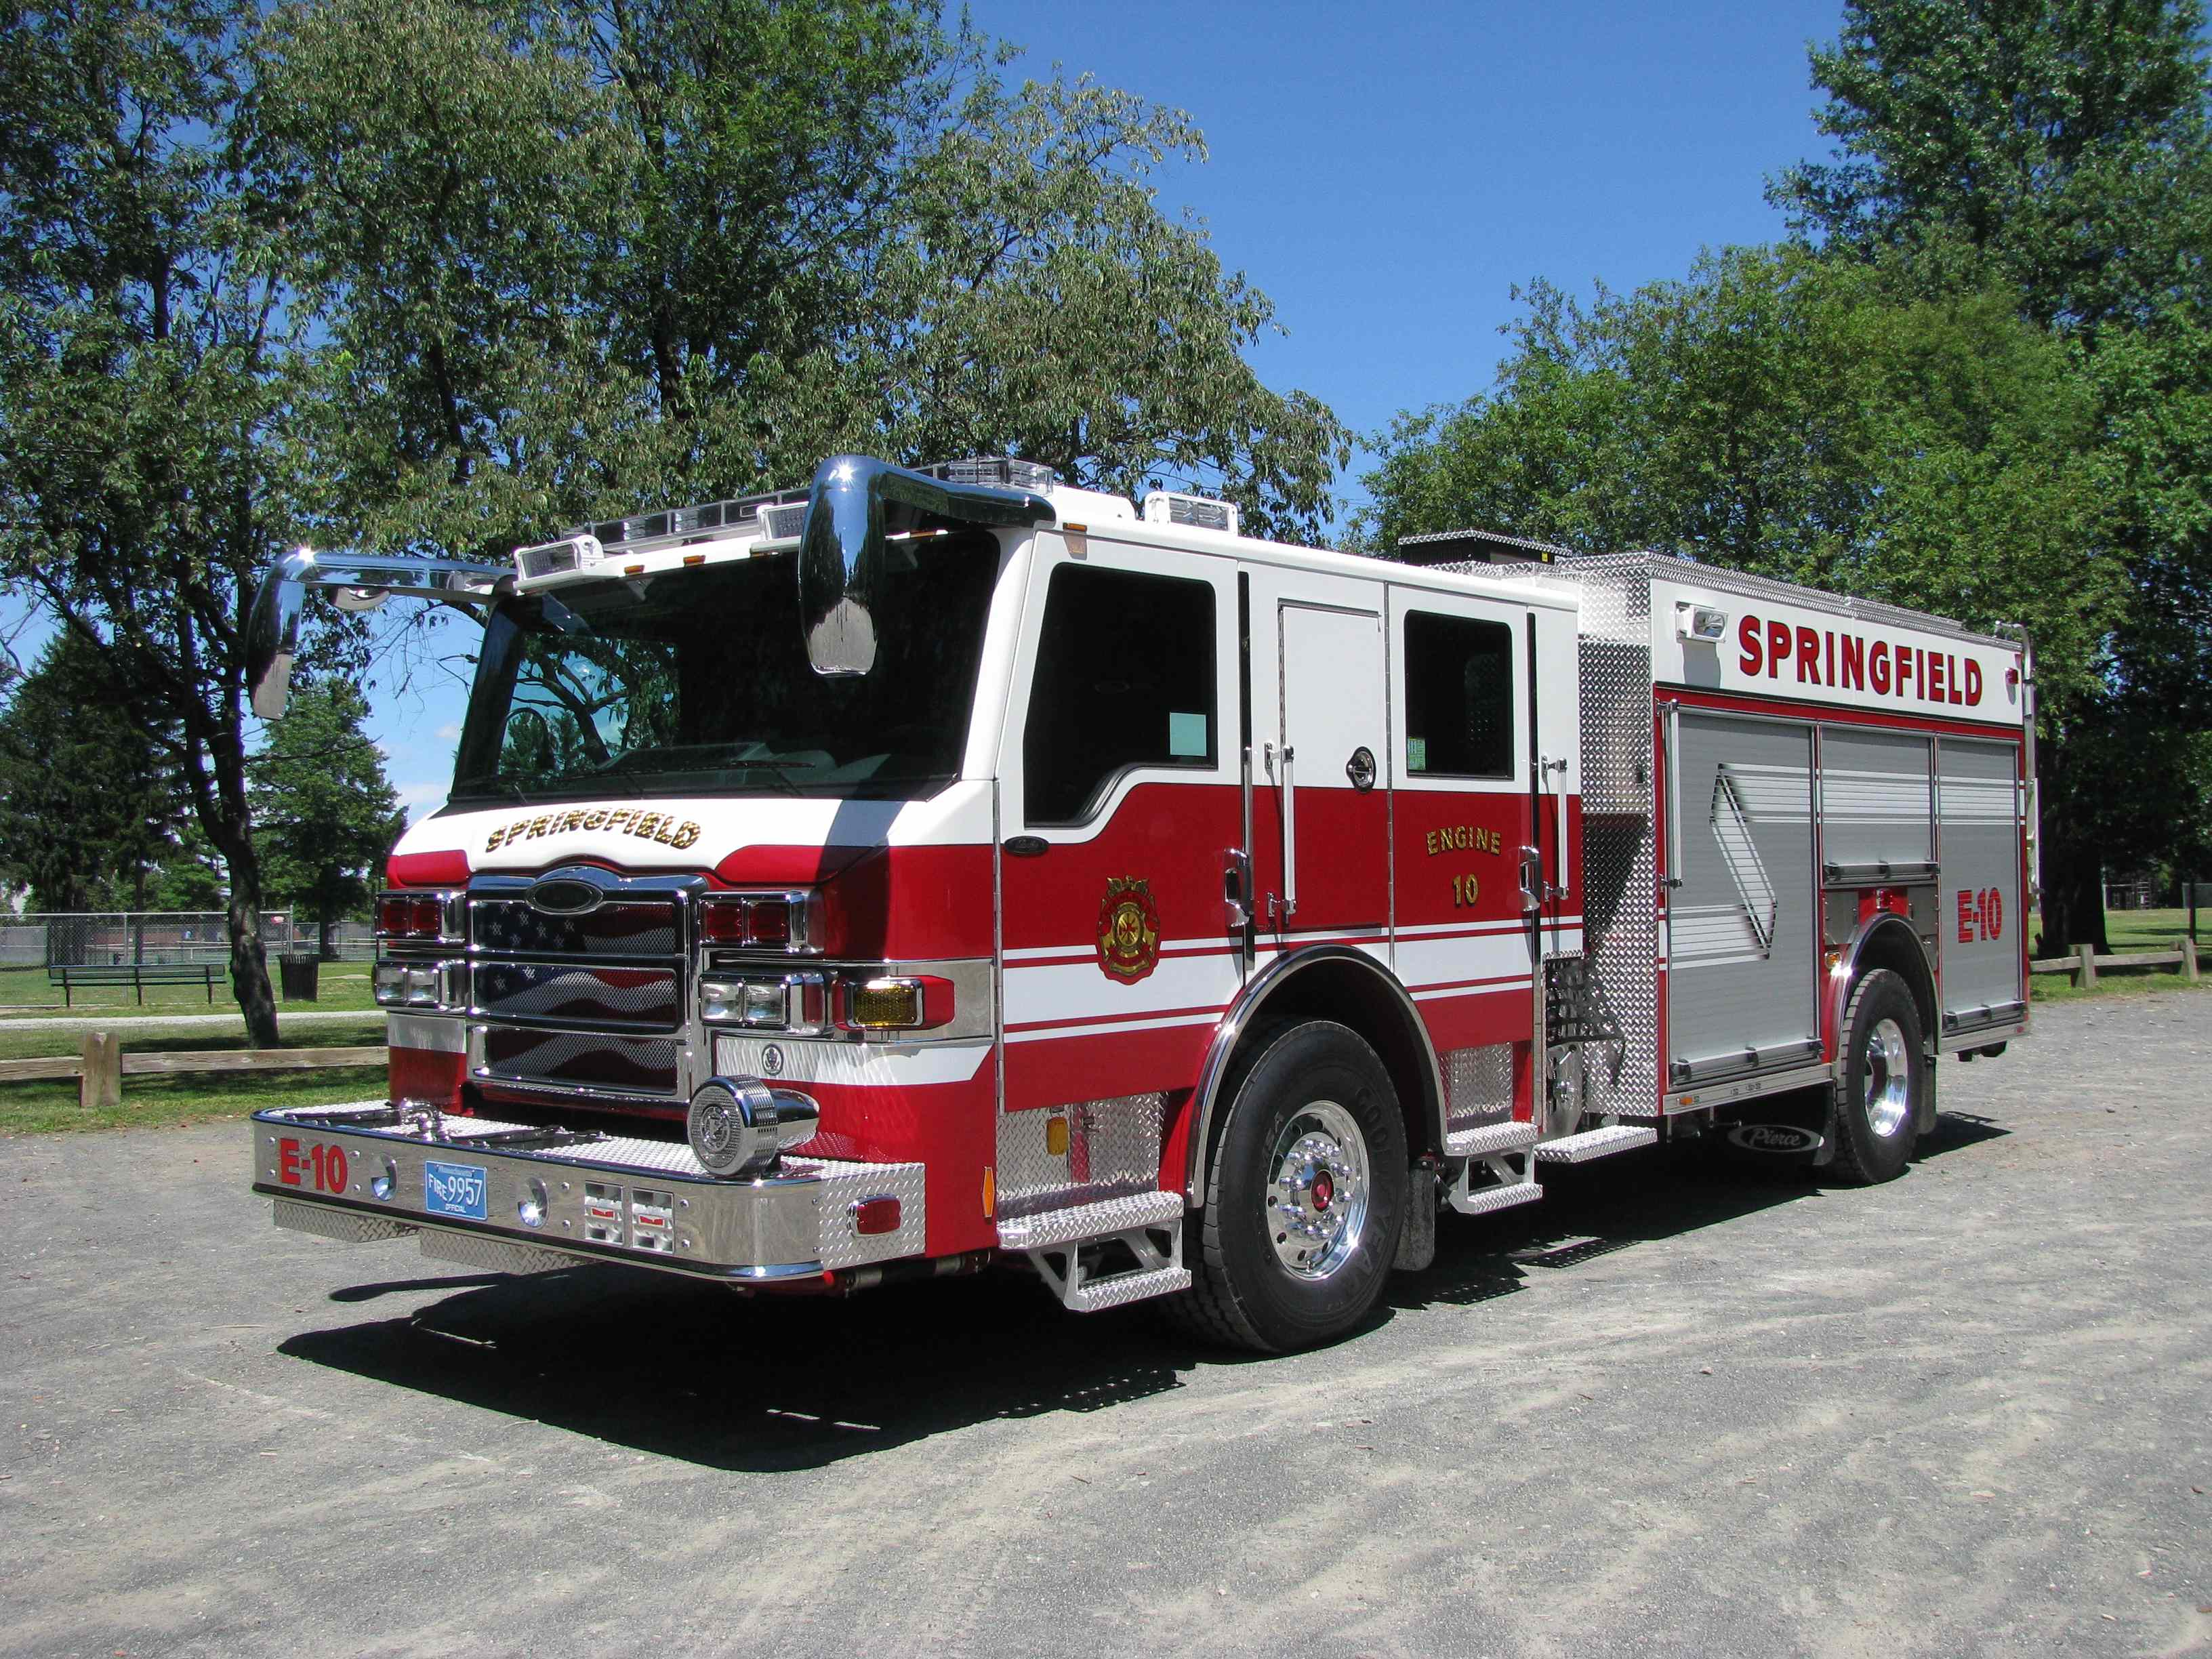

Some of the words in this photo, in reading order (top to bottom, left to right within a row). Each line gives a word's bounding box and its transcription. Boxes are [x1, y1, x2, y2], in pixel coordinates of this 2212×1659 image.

[1739, 615, 1983, 706] SPRINGFIELD
[485, 808, 702, 853] SPRINGFIELD
[1426, 825, 1502, 855] ENGINE
[1452, 874, 1479, 905] 10
[1957, 887, 2003, 943] E-10
[1748, 1127, 1801, 1147] Pierce
[279, 1137, 348, 1194] E-10
[428, 1173, 448, 1202] FIRE
[447, 1176, 483, 1206] 9957
